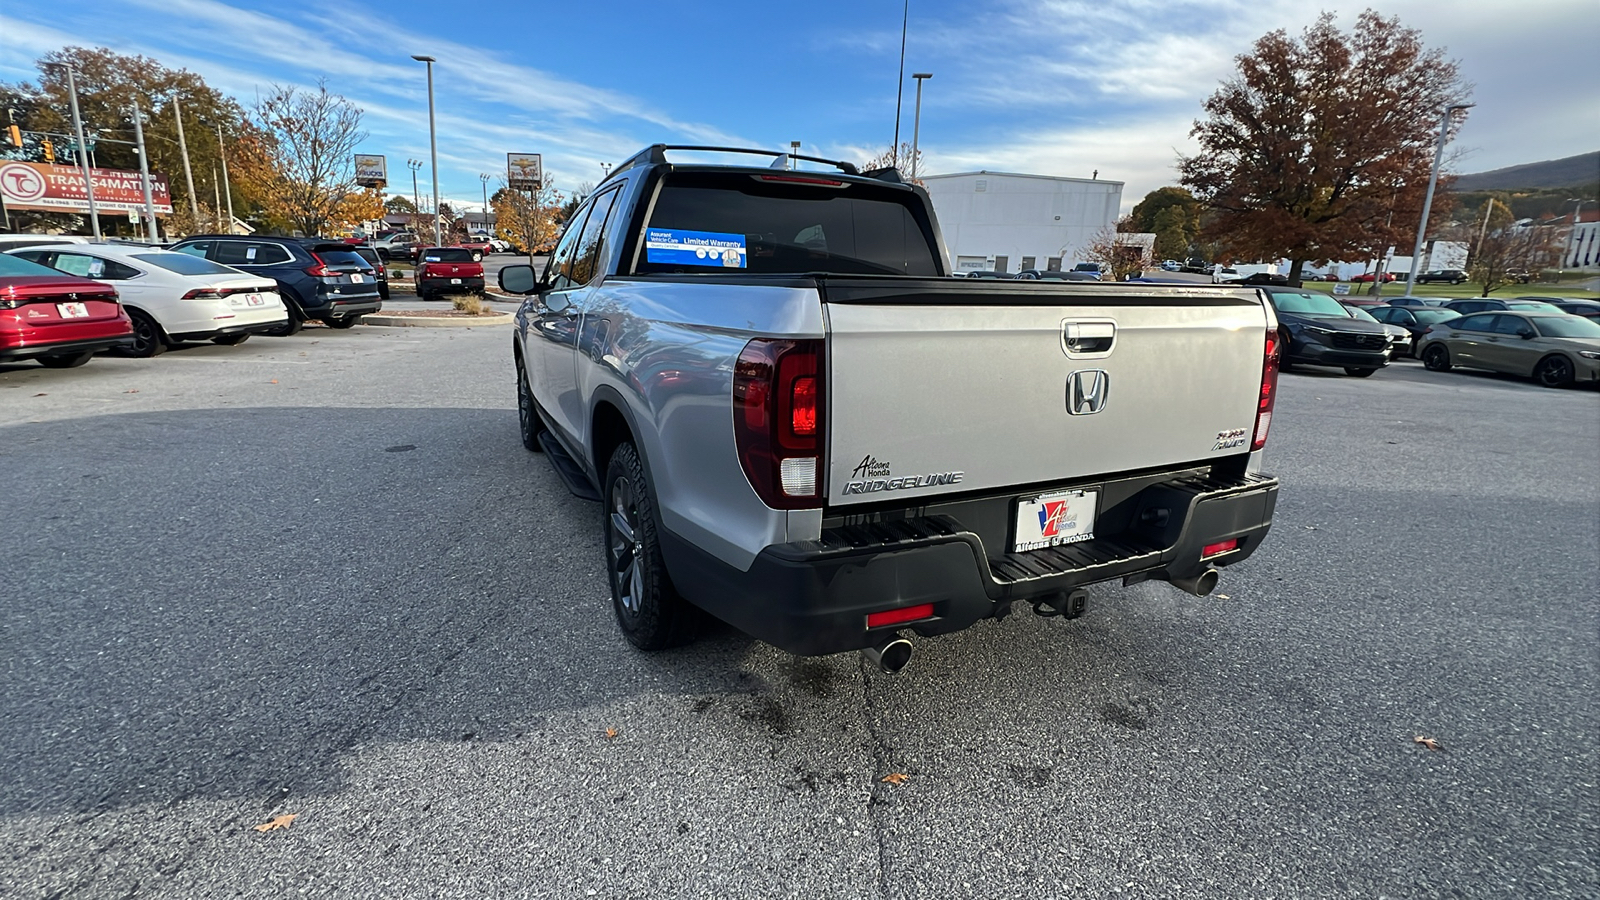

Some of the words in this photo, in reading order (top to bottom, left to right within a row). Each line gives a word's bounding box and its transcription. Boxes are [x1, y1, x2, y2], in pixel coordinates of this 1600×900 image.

[93, 187, 167, 199] CHURH
[683, 237, 709, 246] Limited
[709, 239, 741, 248] Warranty
[867, 469, 890, 477] Honda
[842, 471, 964, 495] RIDGELINE
[1015, 541, 1049, 552] Altoona
[1062, 534, 1095, 544] HONDA
